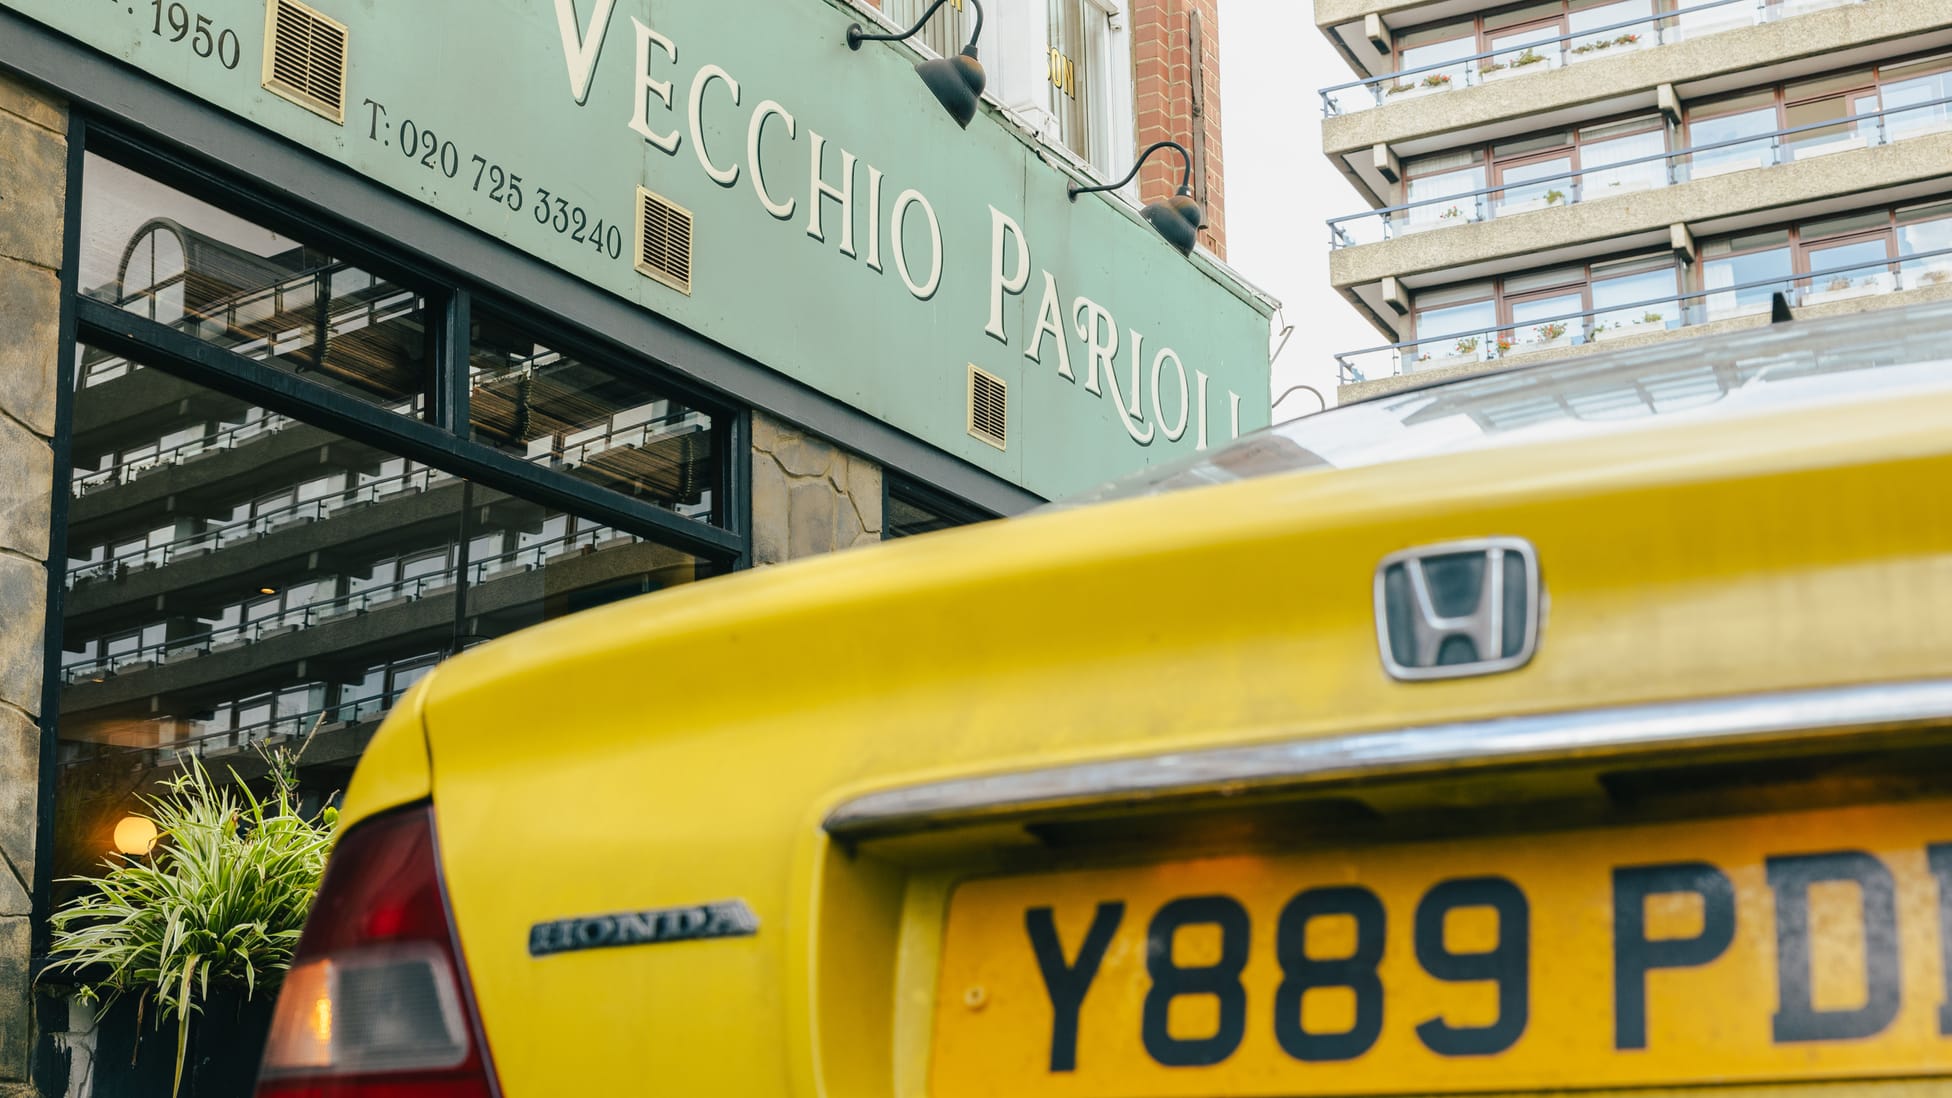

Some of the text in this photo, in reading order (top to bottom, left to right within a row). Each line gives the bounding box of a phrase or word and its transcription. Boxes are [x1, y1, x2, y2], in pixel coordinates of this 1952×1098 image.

[151, 0, 241, 70] 1950
[1047, 47, 1075, 101] ON
[363, 97, 622, 260] T: 020 725 33240
[536, 899, 760, 951] HONDA
[1024, 841, 1952, 1074] Y889 PD
